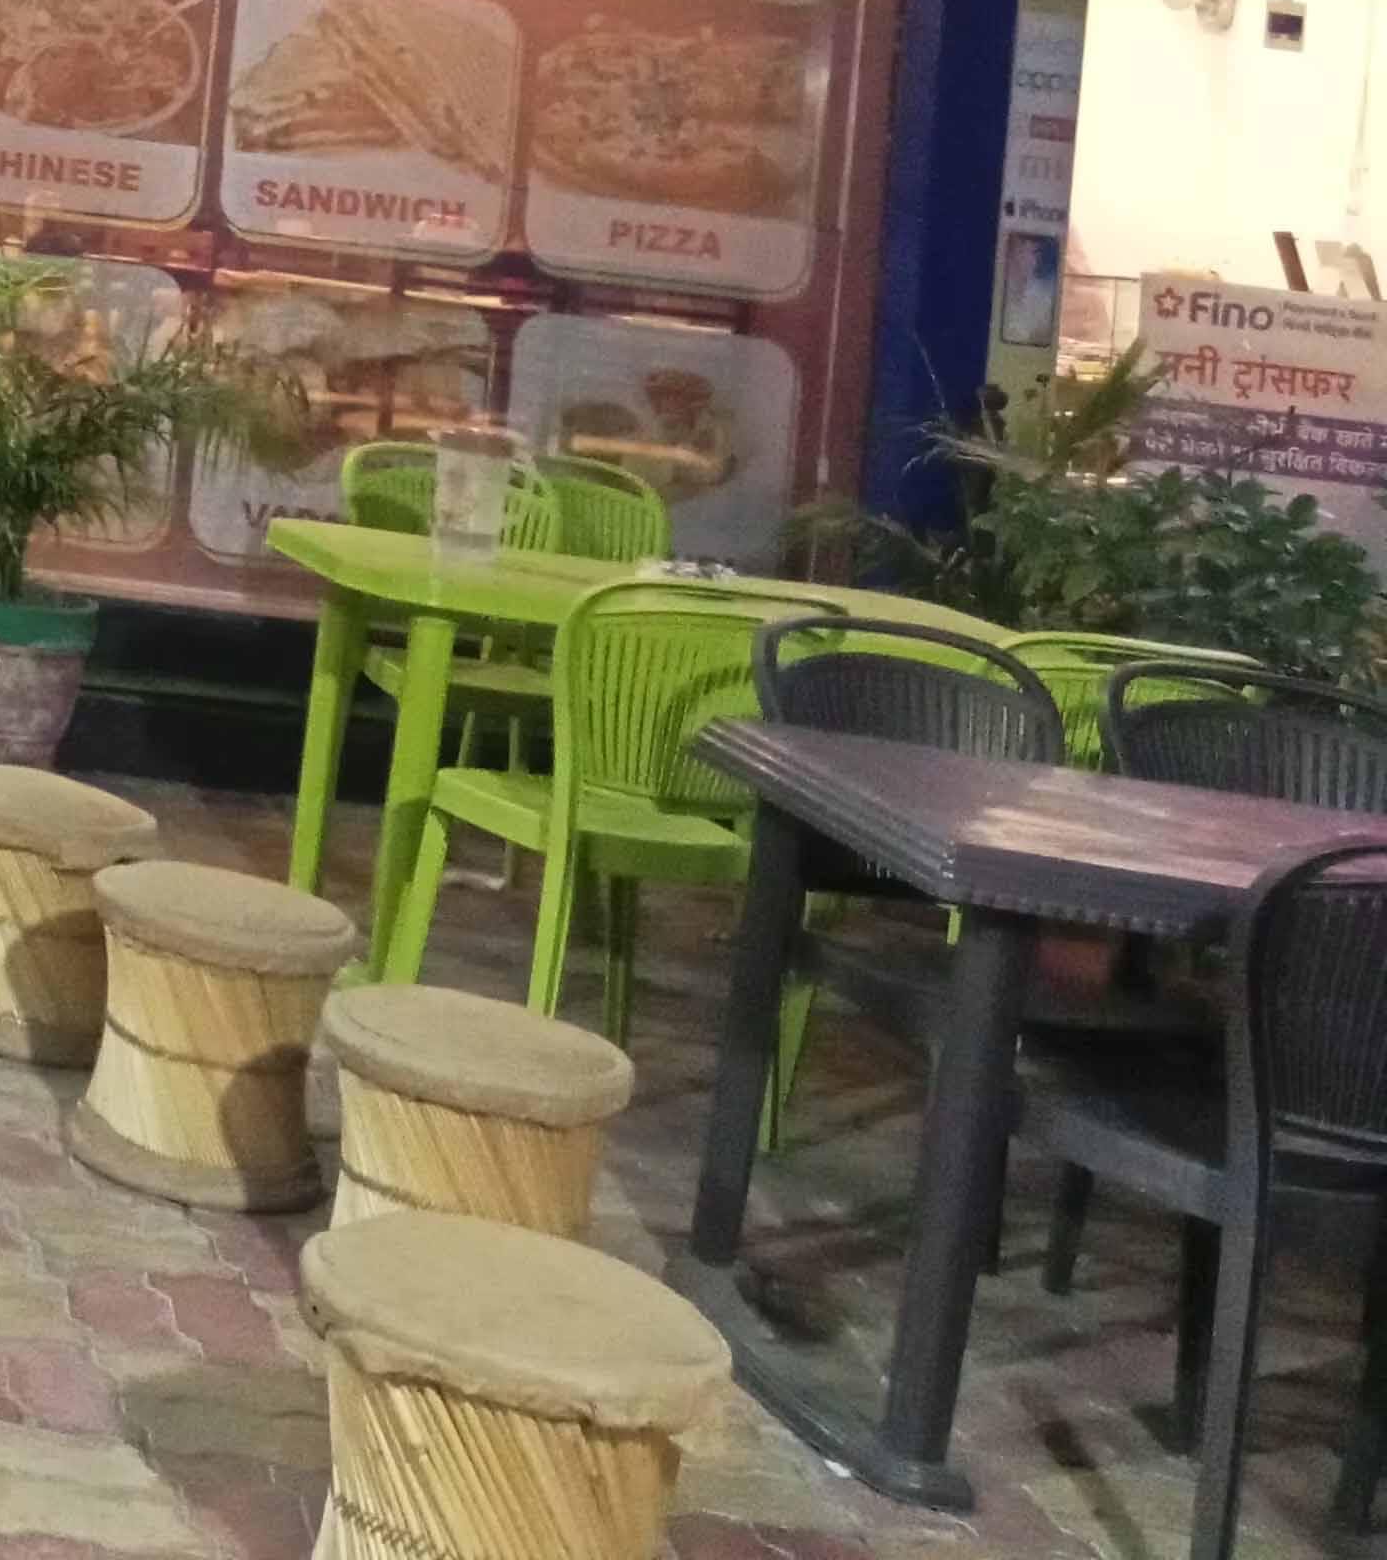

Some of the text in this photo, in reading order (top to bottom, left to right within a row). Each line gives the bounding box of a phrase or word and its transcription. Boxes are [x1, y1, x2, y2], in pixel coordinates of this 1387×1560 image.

[255, 180, 468, 228] SANDWICH
[609, 219, 722, 262] PIZZA
[1188, 291, 1274, 330] Fino
